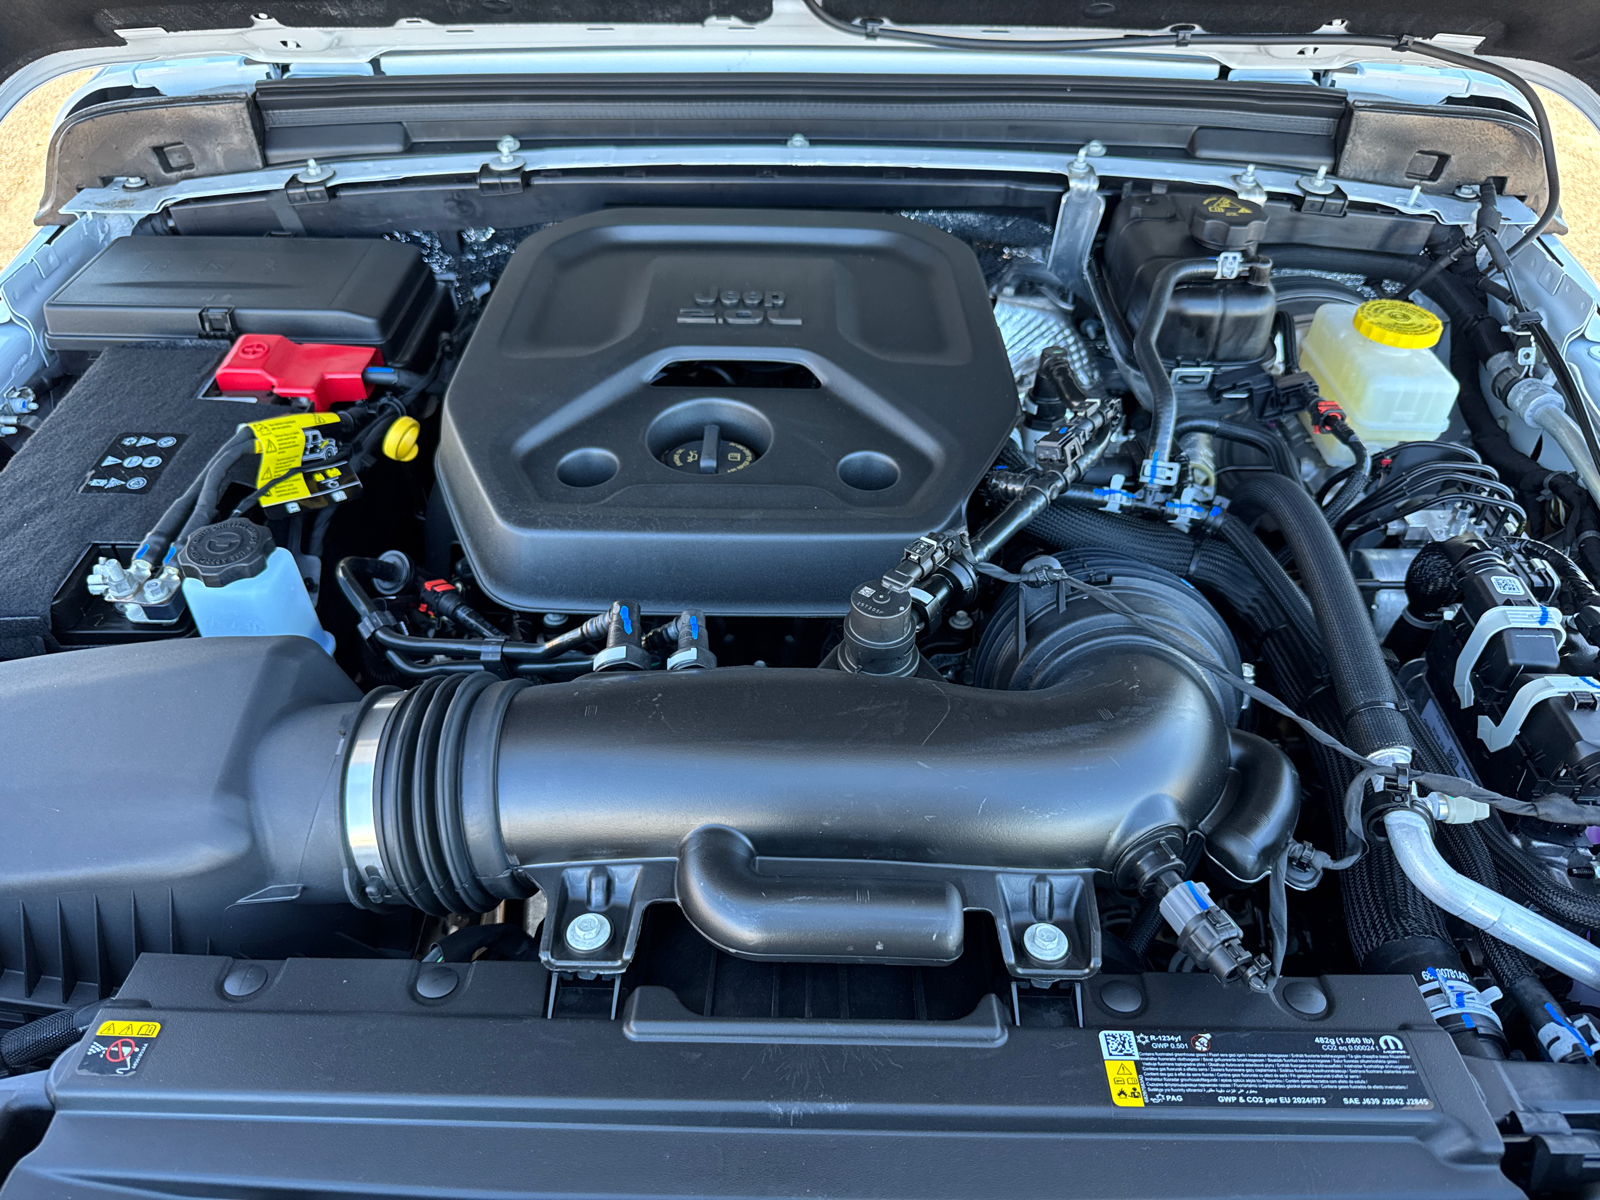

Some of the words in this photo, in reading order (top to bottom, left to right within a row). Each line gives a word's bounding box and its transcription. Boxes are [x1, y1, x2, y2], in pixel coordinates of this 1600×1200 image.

[694, 286, 786, 308] Jeep
[1314, 1036, 1336, 1045] 482g
[1165, 1094, 1184, 1102] PAG
[1217, 1095, 1237, 1103] GWP
[1238, 1095, 1246, 1103] &
[1264, 1097, 1278, 1105] per
[1278, 1096, 1291, 1104] EU
[1342, 1097, 1360, 1105] SAE
